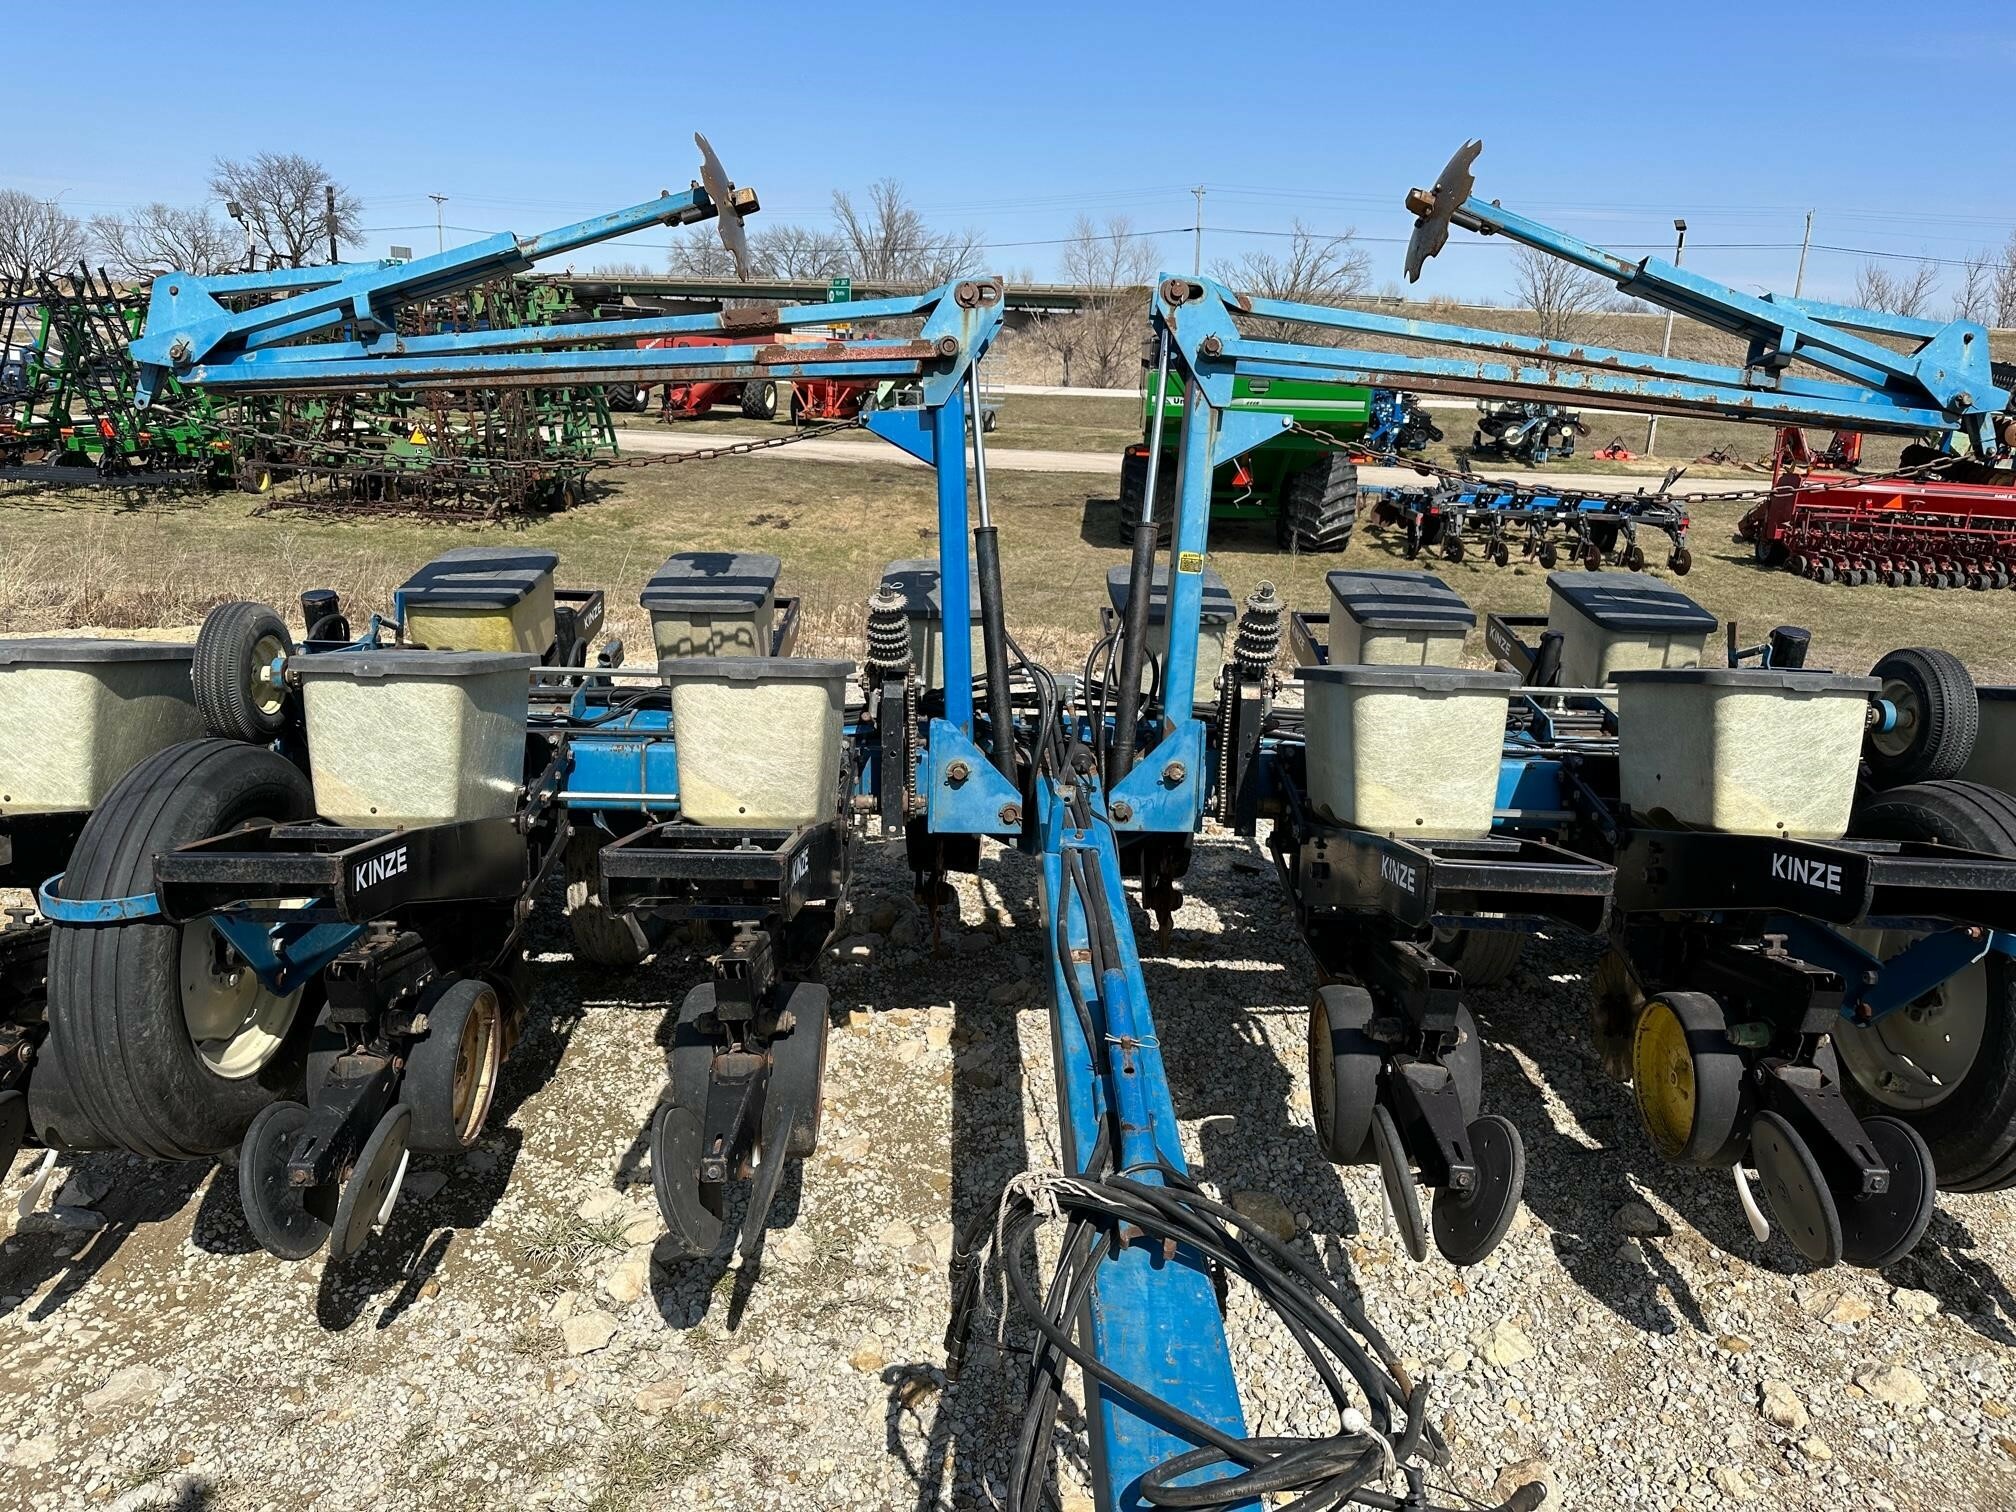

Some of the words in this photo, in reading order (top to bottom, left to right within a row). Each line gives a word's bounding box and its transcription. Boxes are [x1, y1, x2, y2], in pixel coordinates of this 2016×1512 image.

[583, 601, 602, 630] KINZE
[1489, 625, 1511, 657] KINZE
[356, 846, 408, 892] KINZE
[1381, 854, 1416, 893] KINZE
[1771, 852, 1842, 892] KINZE
